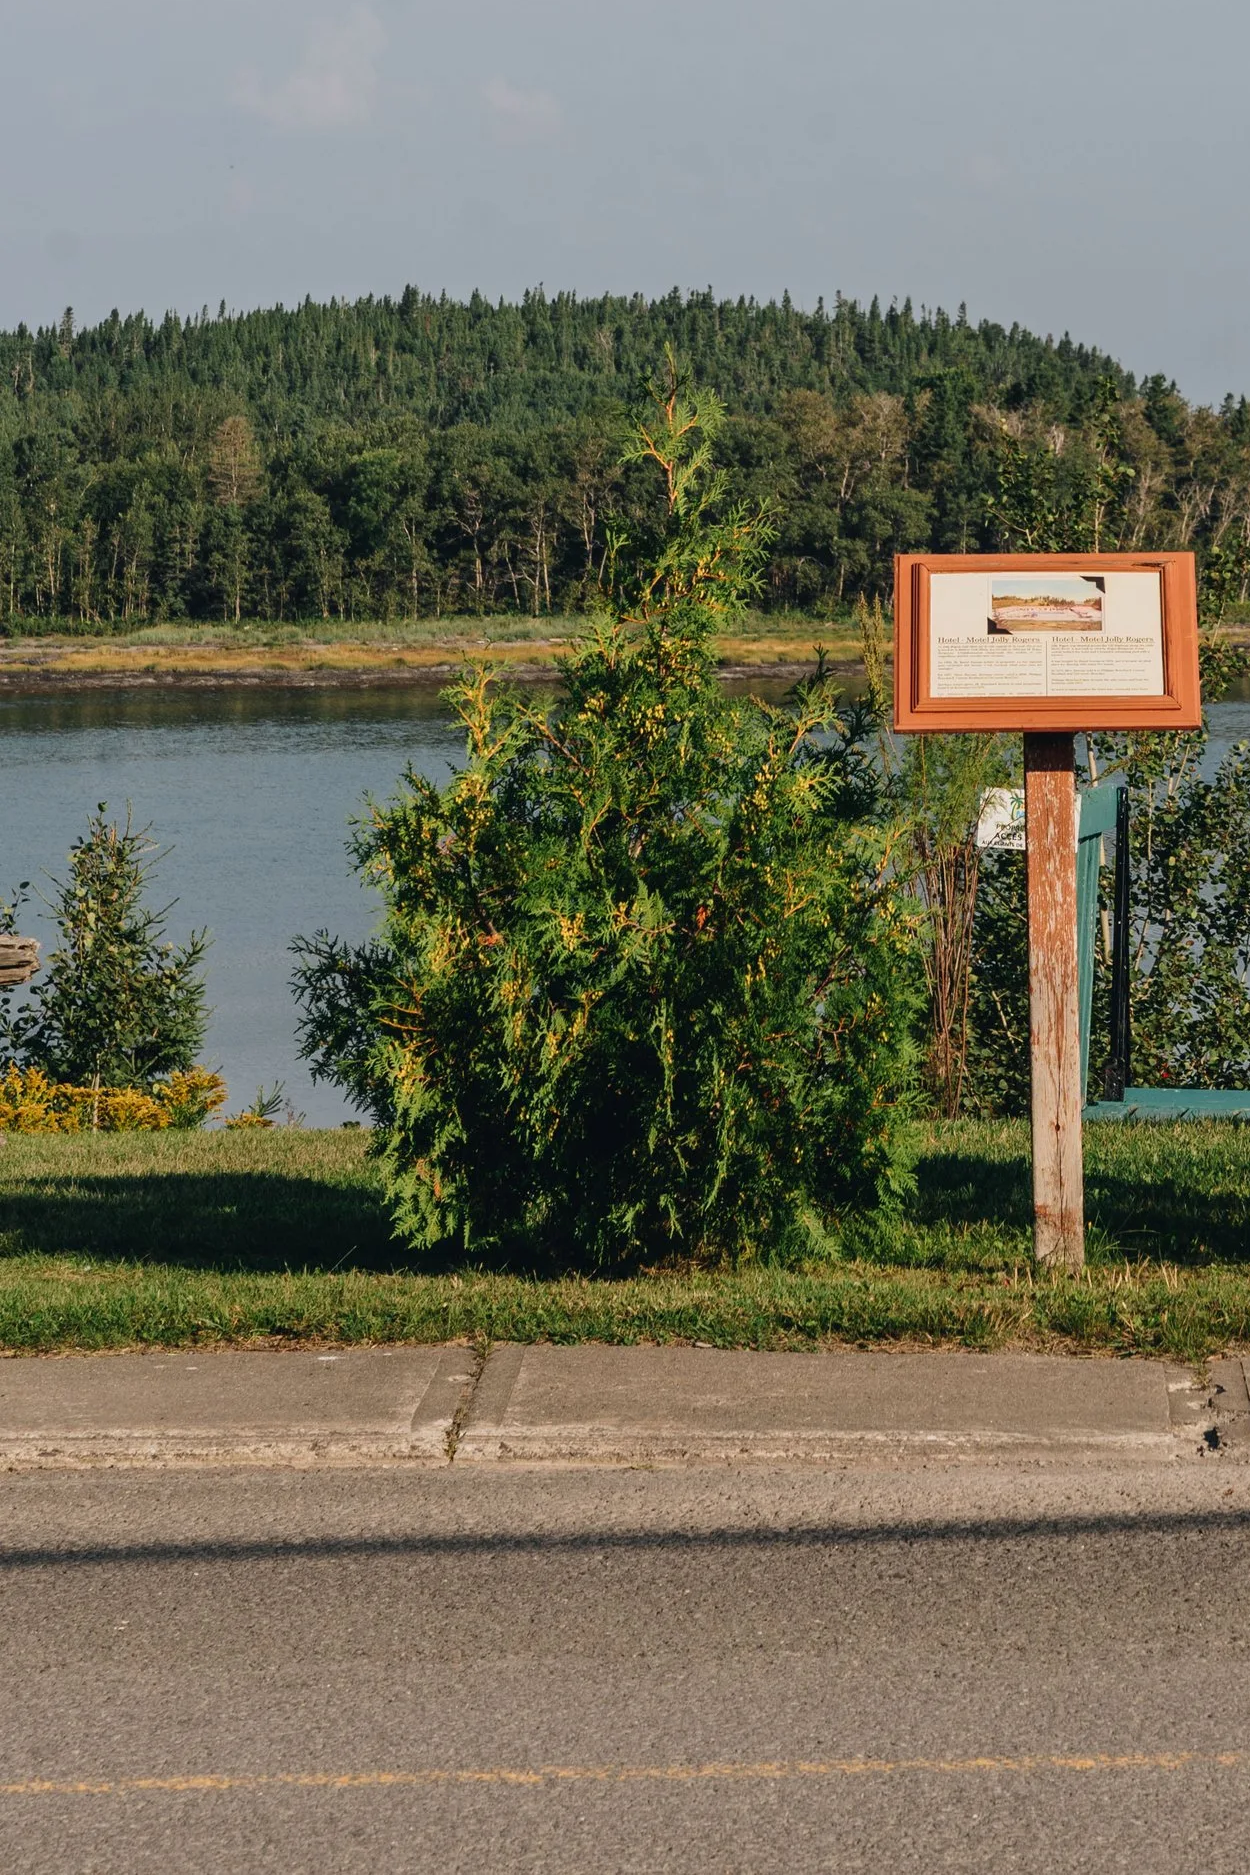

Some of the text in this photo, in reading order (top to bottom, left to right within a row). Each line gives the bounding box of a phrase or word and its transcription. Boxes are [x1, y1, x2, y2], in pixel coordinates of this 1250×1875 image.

[938, 636, 960, 644] Hotel
[966, 636, 990, 644] Motel
[991, 636, 1009, 644] Jolly
